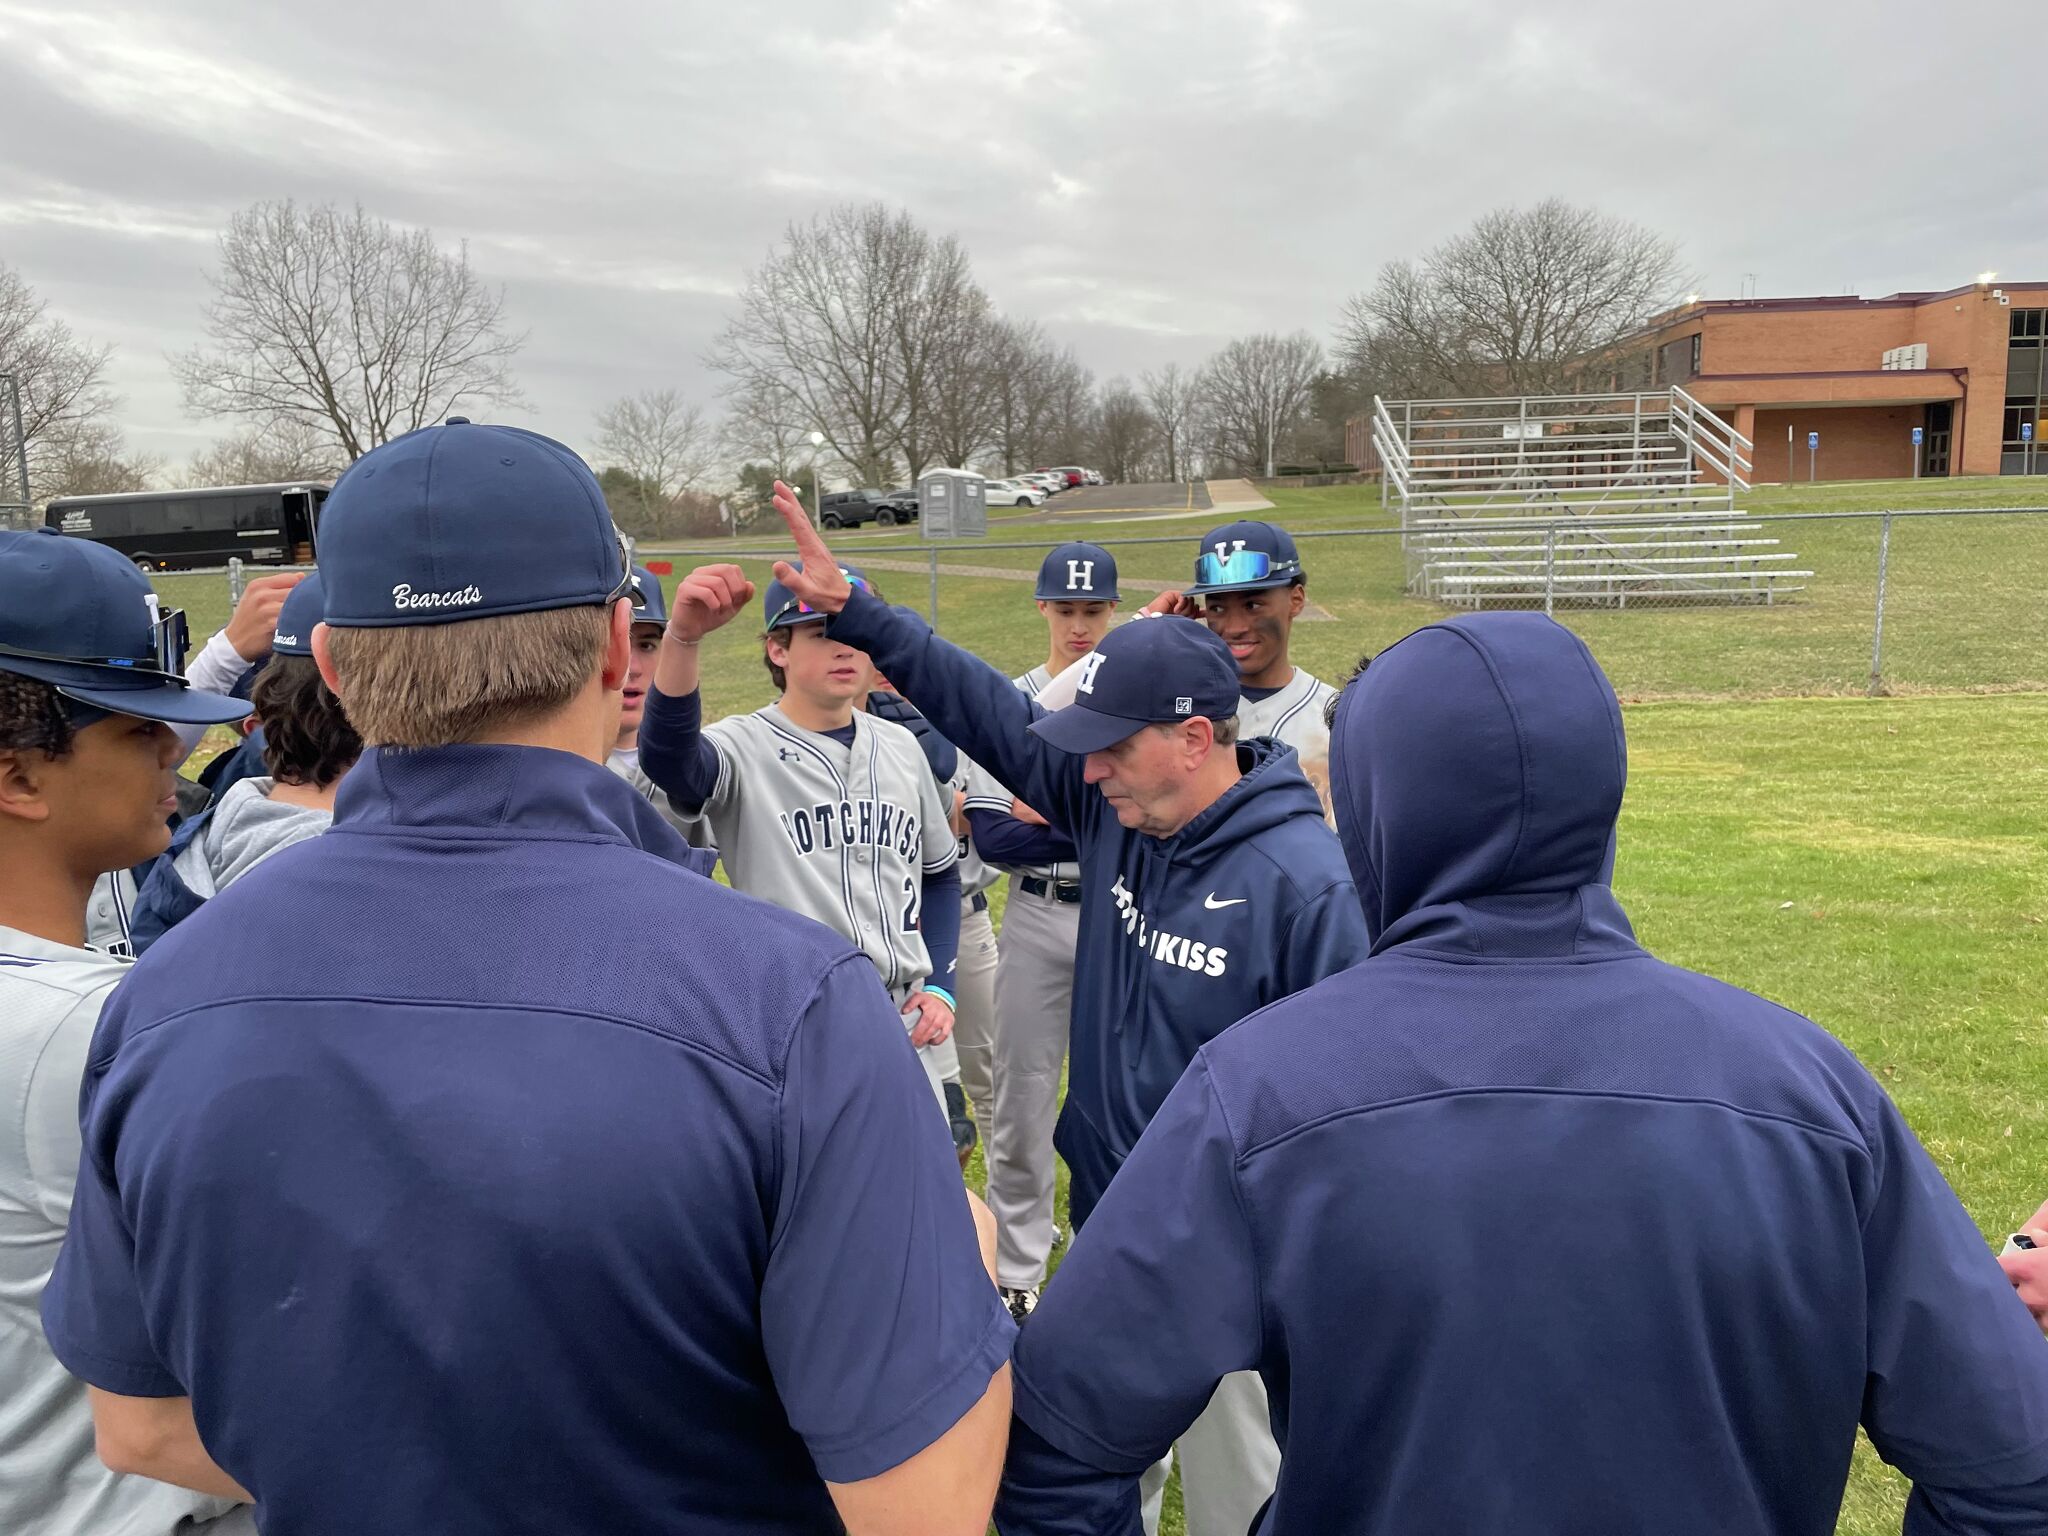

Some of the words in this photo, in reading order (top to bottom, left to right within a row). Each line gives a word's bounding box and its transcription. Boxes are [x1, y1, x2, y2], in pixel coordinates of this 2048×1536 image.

[1066, 560, 1095, 591] H
[392, 583, 483, 609] Bearcats
[1079, 651, 1107, 695] H
